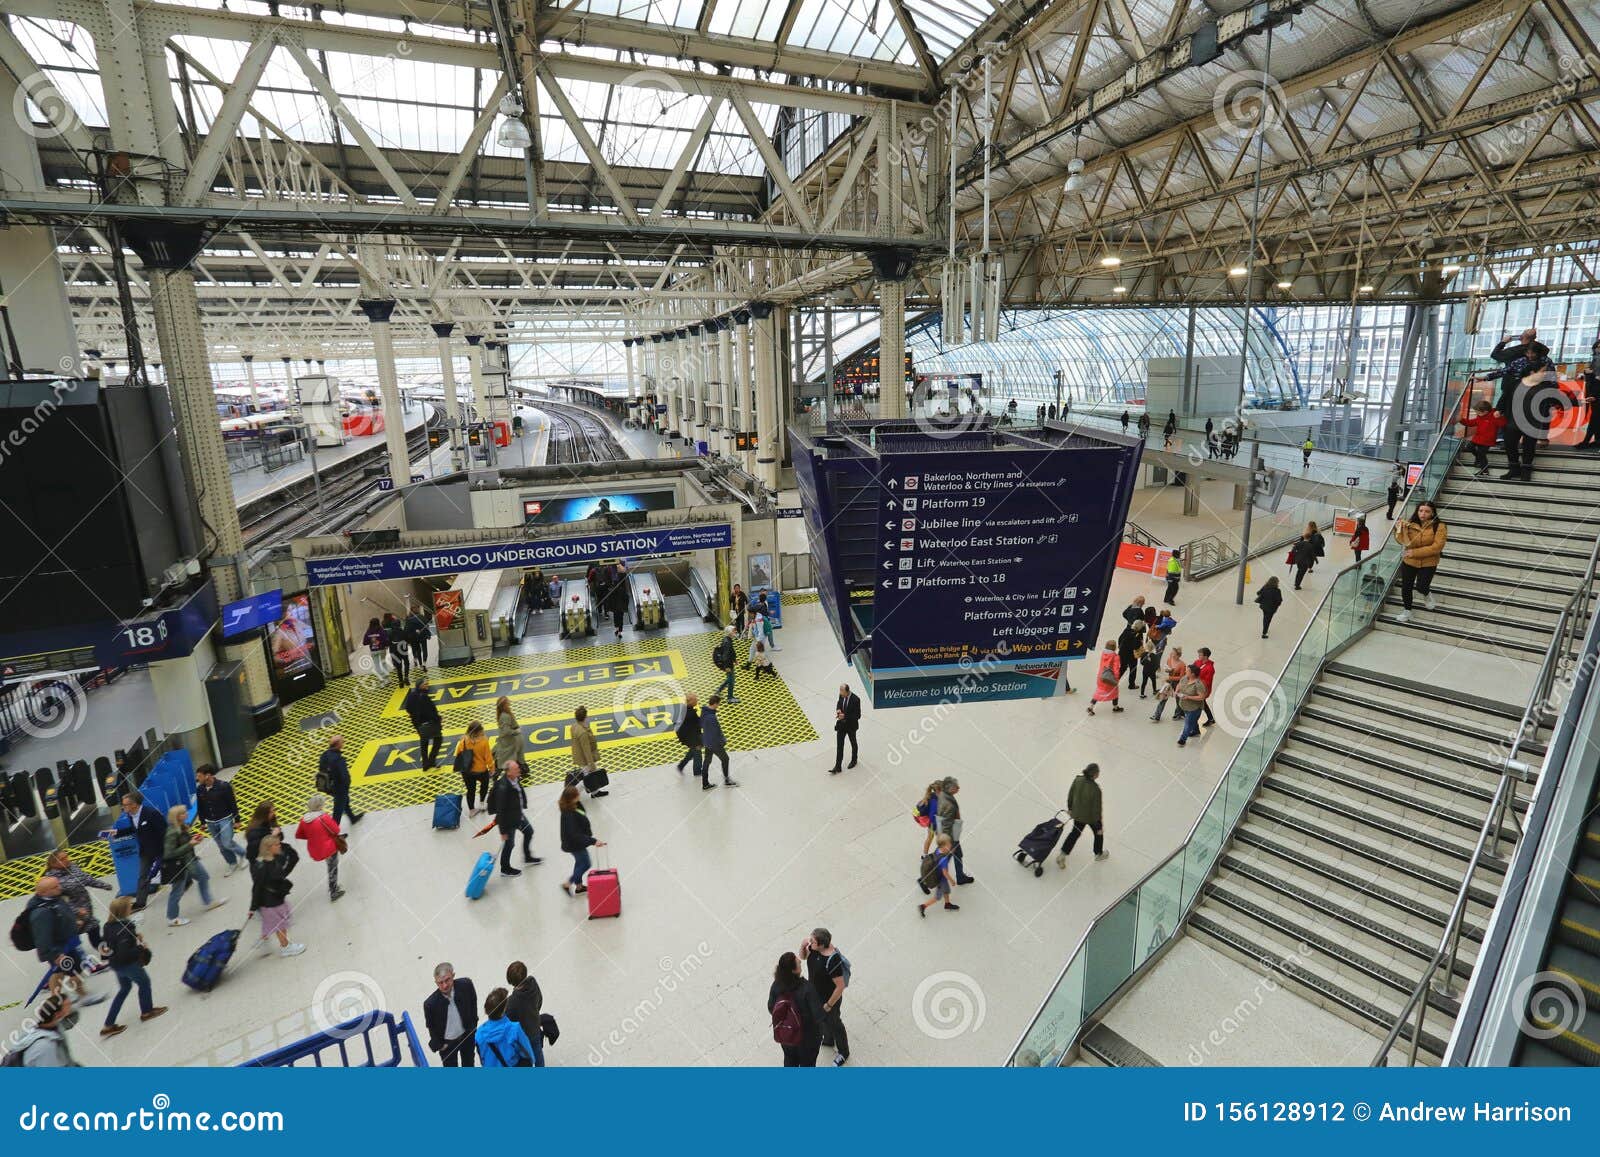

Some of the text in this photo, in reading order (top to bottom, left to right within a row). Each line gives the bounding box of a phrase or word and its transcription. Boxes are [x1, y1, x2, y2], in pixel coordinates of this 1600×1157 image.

[924, 470, 1022, 482] Bakerloo, Northern and
[380, 480, 390, 488] 17
[924, 482, 963, 490] Waterloo
[974, 481, 991, 490] City
[993, 480, 1013, 488] lines
[922, 497, 986, 509] Platform 19
[920, 519, 959, 530] Jubilee
[962, 518, 981, 528] line
[996, 518, 1030, 526] escalators
[920, 536, 1034, 549] Waterloo East Station
[398, 537, 657, 571] WATERLOO UNDERGROUND STATION
[917, 559, 936, 568] Lift
[940, 559, 970, 567] Waterloo
[972, 558, 986, 566] East
[916, 574, 1006, 587] Platforms 1 to 18
[1012, 594, 1026, 602] City
[1042, 590, 1060, 599] Lift
[964, 607, 1057, 621] Platforms 20 to 24
[992, 624, 1054, 636] Left luggage
[124, 626, 155, 648] 18
[908, 645, 960, 654] Waterloo Bridge
[1012, 642, 1052, 654] Way out
[564, 660, 660, 684] KEEP
[884, 682, 1027, 699] Welcome to Waterloo Station
